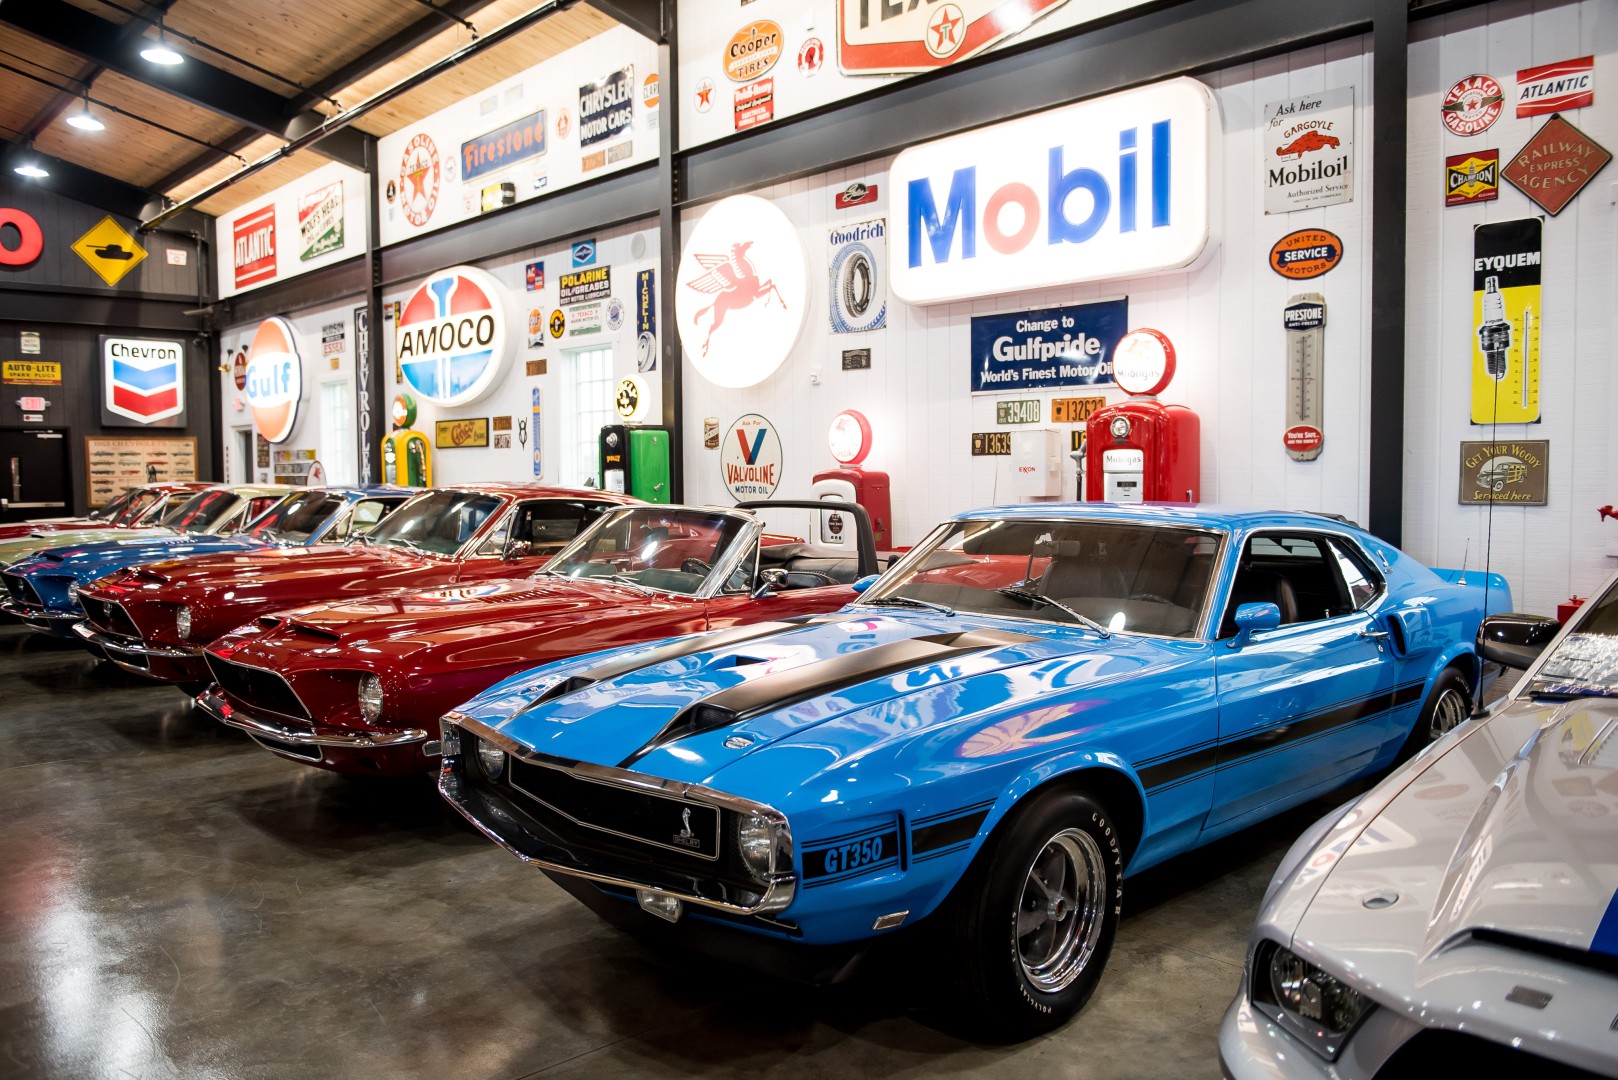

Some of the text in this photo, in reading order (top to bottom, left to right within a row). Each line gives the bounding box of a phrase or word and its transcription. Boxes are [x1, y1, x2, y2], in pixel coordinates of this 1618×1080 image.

[730, 33, 777, 58] Cooper
[737, 57, 769, 78] TIRES
[580, 78, 635, 118] CHRYSLER
[1446, 77, 1499, 102] TEXACO
[1520, 75, 1589, 100] ATLANTIC
[1276, 99, 1322, 117] Ask here
[1445, 106, 1499, 133] GASOLINE
[580, 107, 632, 141] MOTOR CARS
[1267, 118, 1284, 132] for
[1283, 120, 1335, 139] GARGOYLE
[463, 121, 544, 174] Firestone
[1517, 141, 1595, 168] RAILWAY
[1269, 154, 1348, 188] Mobiloil
[1530, 157, 1581, 173] EXPRESS
[1517, 166, 1590, 189] AGENCY
[907, 118, 1172, 270] Mobil
[1287, 184, 1349, 198] Authorized Service
[830, 222, 884, 246] Goodrich
[1285, 234, 1327, 247] UNITED
[235, 225, 275, 269] ATLANTIC
[1283, 246, 1328, 262] SERVICE
[1285, 261, 1327, 275] MOTORS
[1474, 250, 1541, 272] EYQUEM
[560, 280, 609, 298] OIL GREASES
[561, 267, 608, 289] POLARINE
[641, 272, 650, 330] MICHELIN
[1016, 316, 1075, 334] Change to
[1285, 307, 1323, 322] PRESTONE
[400, 314, 495, 359] AMOCO
[992, 332, 1100, 362] Gulfpride
[110, 342, 177, 360] Chevron
[7, 364, 57, 372] AUTO-LITE
[980, 361, 1113, 383] World's Finest Motor Oil
[246, 361, 291, 399] Gulf
[358, 312, 371, 486] CHEVROLET
[1465, 444, 1542, 469] GET YOUR WOODY
[727, 462, 775, 486] VALVOLINE
[1018, 466, 1036, 474] EXXON
[735, 485, 769, 495] MOTOR OIL
[1473, 490, 1532, 500] Serviced here
[824, 836, 883, 873] GT350
[1091, 812, 1123, 916] GOODYEAR
